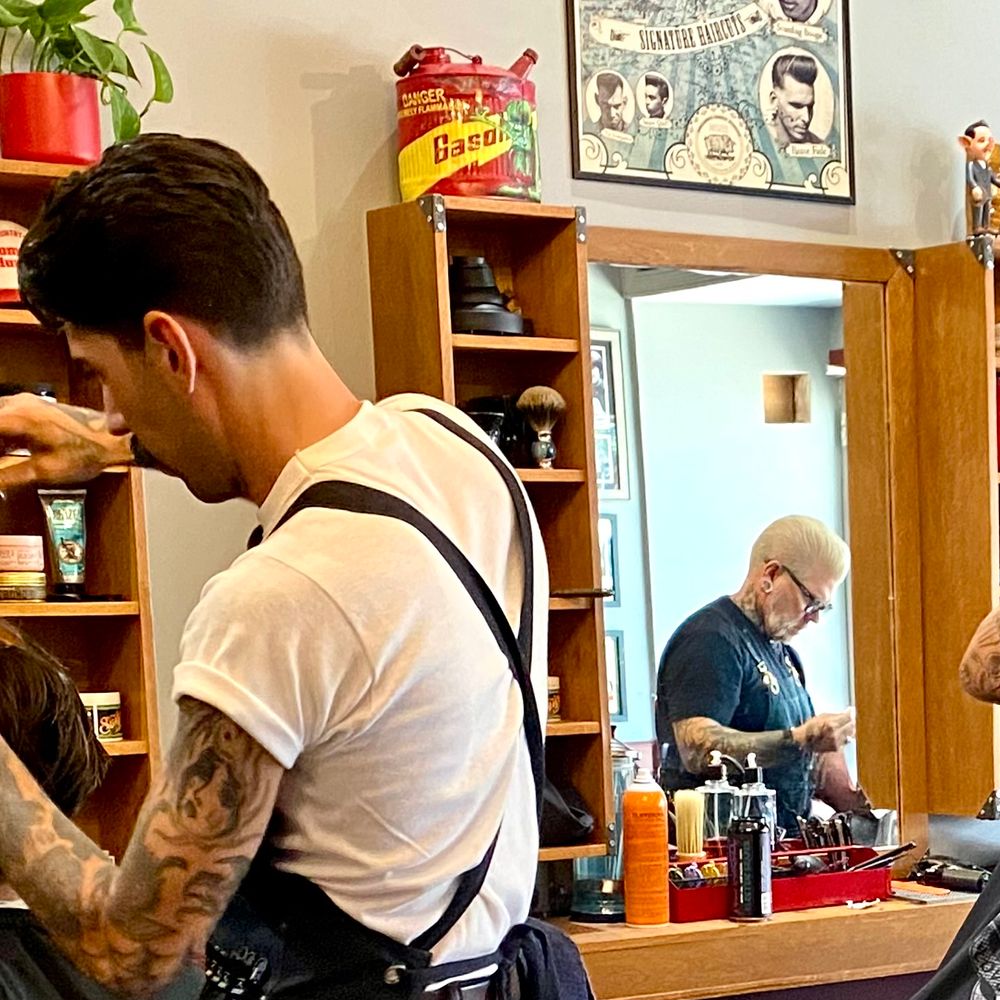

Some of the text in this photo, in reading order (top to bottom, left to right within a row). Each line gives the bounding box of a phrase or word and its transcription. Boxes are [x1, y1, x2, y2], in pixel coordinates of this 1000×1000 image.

[639, 13, 746, 51] SIGNATURE HAIRCUTS
[402, 88, 446, 108] DANGER
